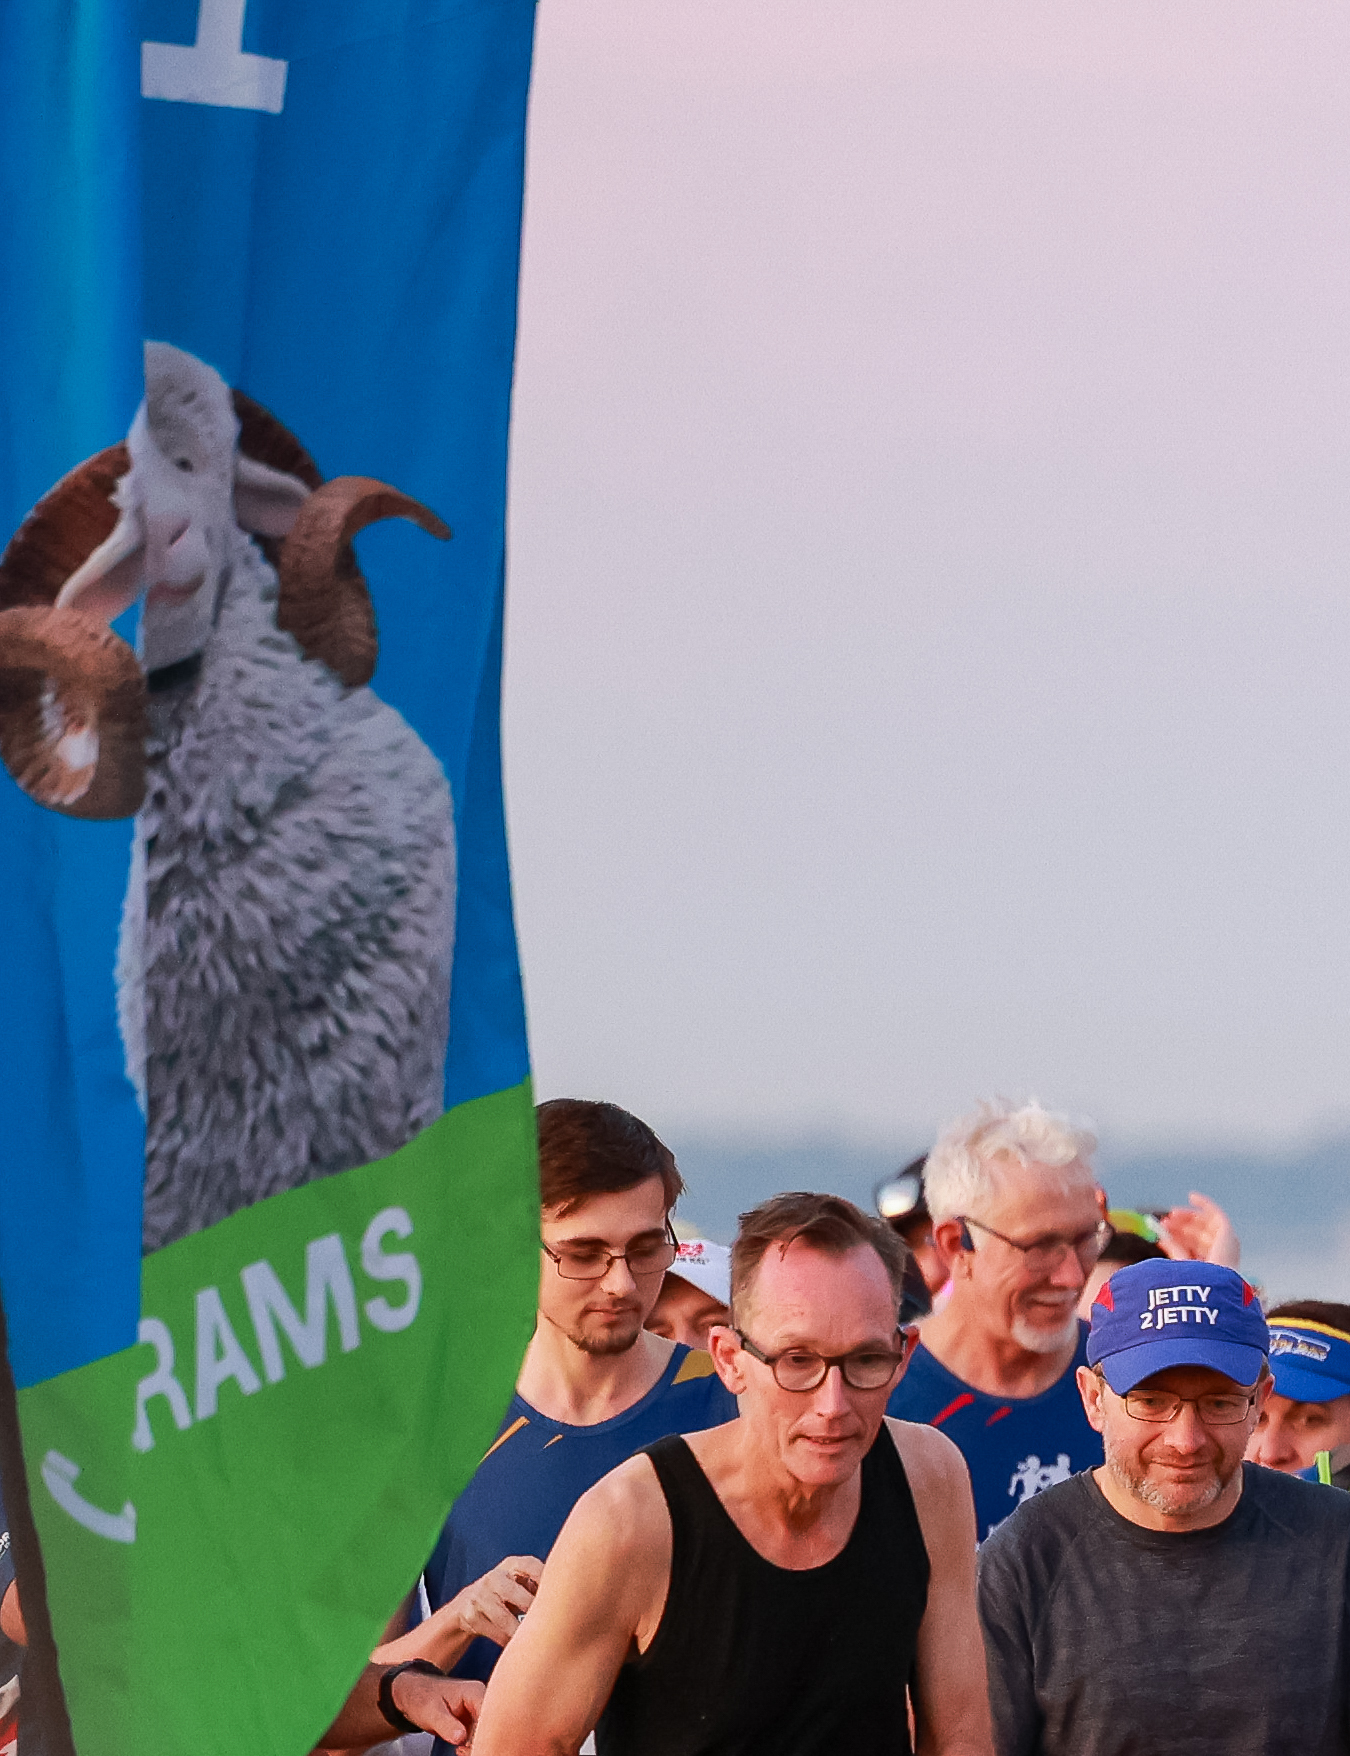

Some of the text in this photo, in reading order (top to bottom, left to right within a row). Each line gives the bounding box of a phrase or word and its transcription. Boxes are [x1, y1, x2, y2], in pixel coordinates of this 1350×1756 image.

[1147, 1285, 1211, 1310] JETTY
[1139, 1306, 1219, 1330] 2 JETTY
